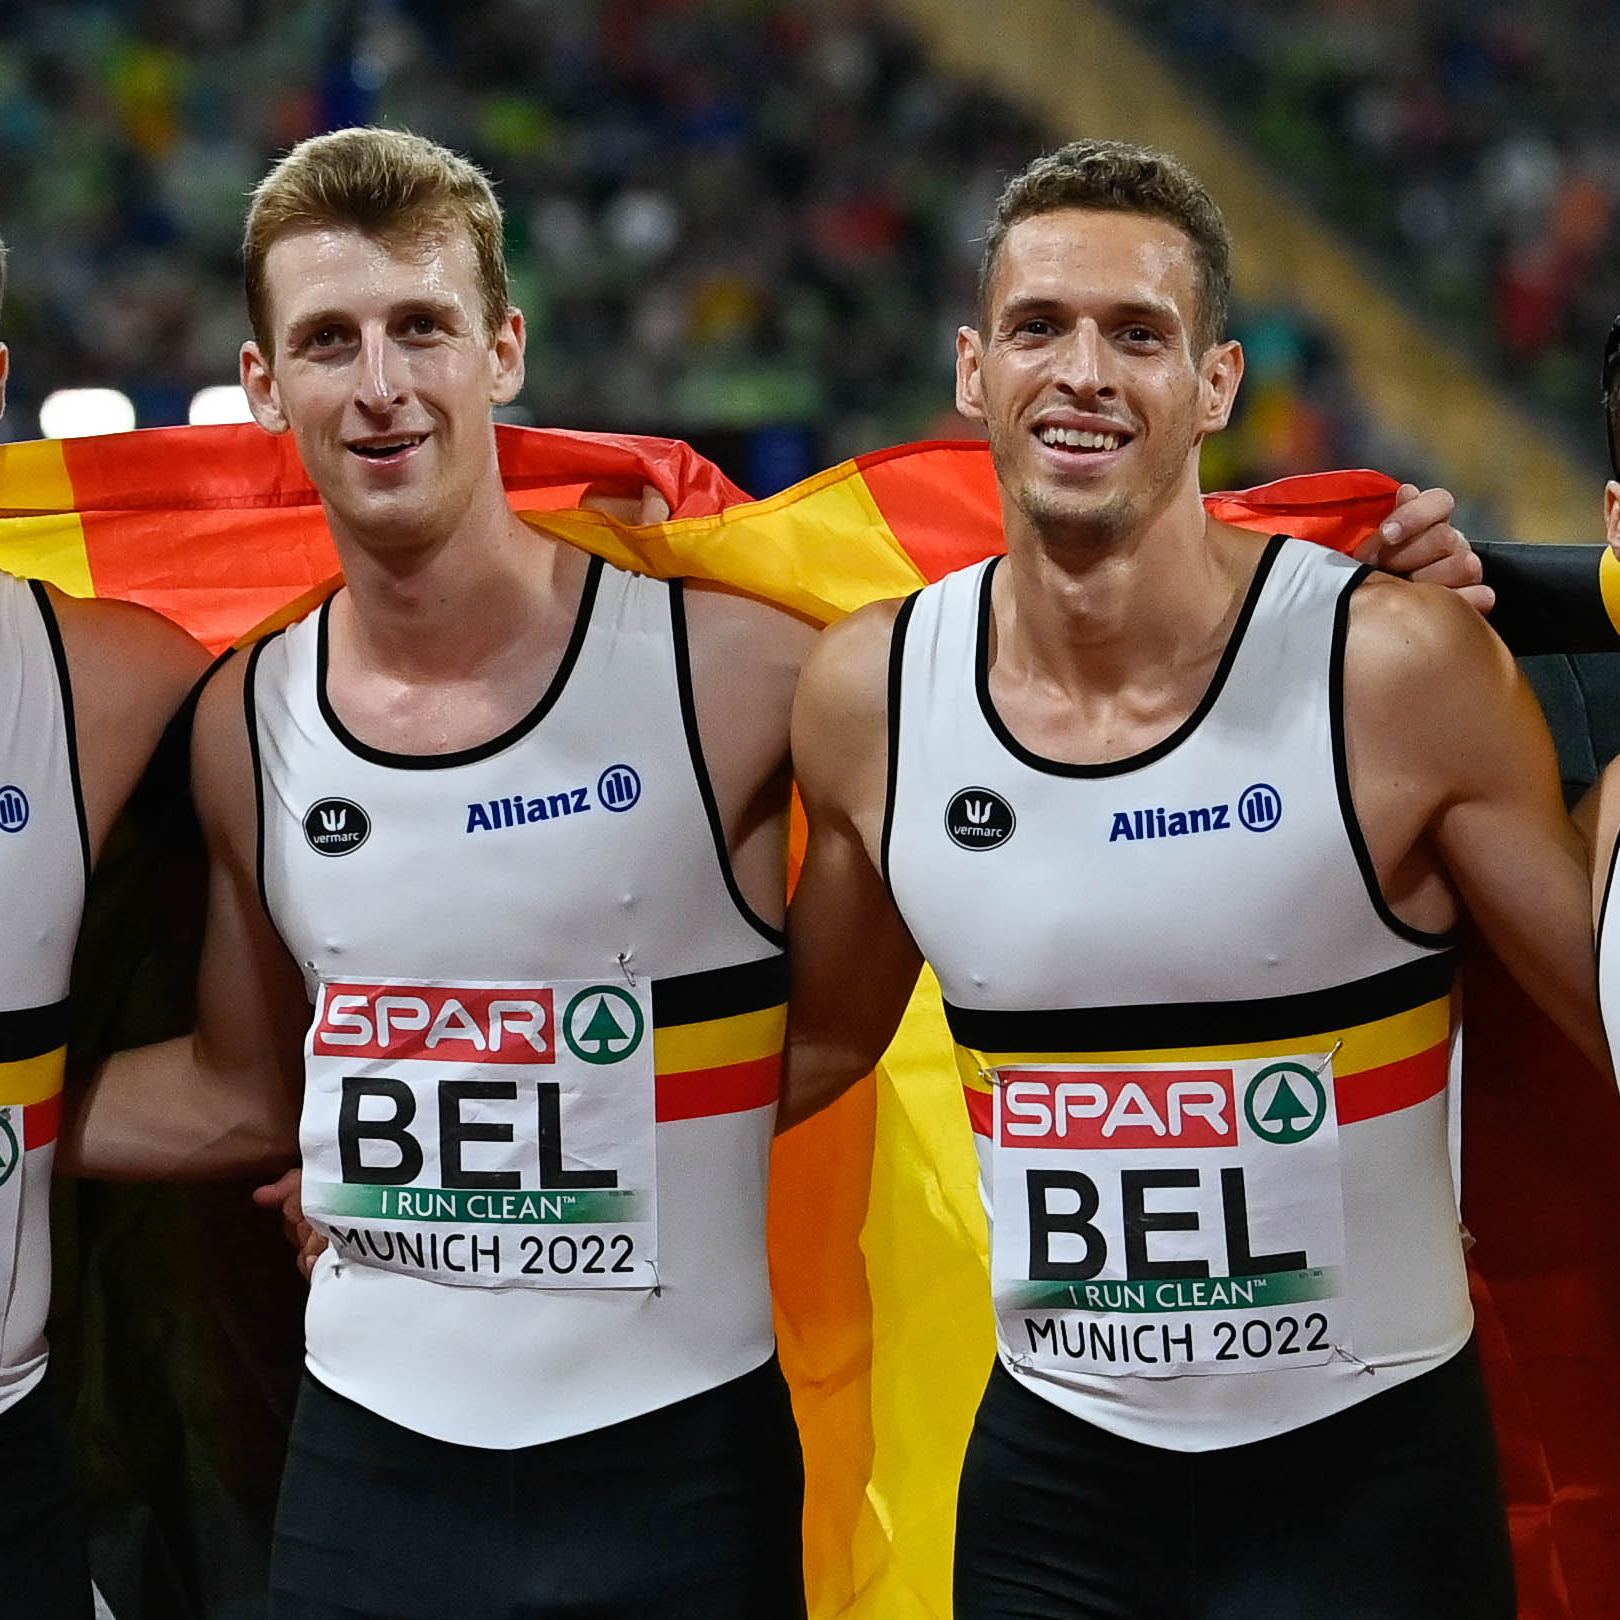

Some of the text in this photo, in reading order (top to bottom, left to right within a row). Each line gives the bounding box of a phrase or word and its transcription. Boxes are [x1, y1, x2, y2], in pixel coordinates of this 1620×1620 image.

[465, 787, 591, 833] Allianz
[954, 823, 1002, 838] vermarc
[1109, 803, 1230, 842] Allianz
[313, 830, 360, 845] vermarc
[321, 995, 547, 1053] SPAR
[338, 1077, 618, 1188] BEL
[1006, 1082, 1229, 1138] SPAR
[381, 1192, 388, 1215] I
[398, 1193, 456, 1218] RUN
[1026, 1167, 1307, 1281] BEL
[328, 1225, 634, 1274] MUNICH 2022
[1069, 1284, 1077, 1306] I
[1087, 1285, 1145, 1308] RUN
[1025, 1312, 1330, 1362] MUNICH 2022
